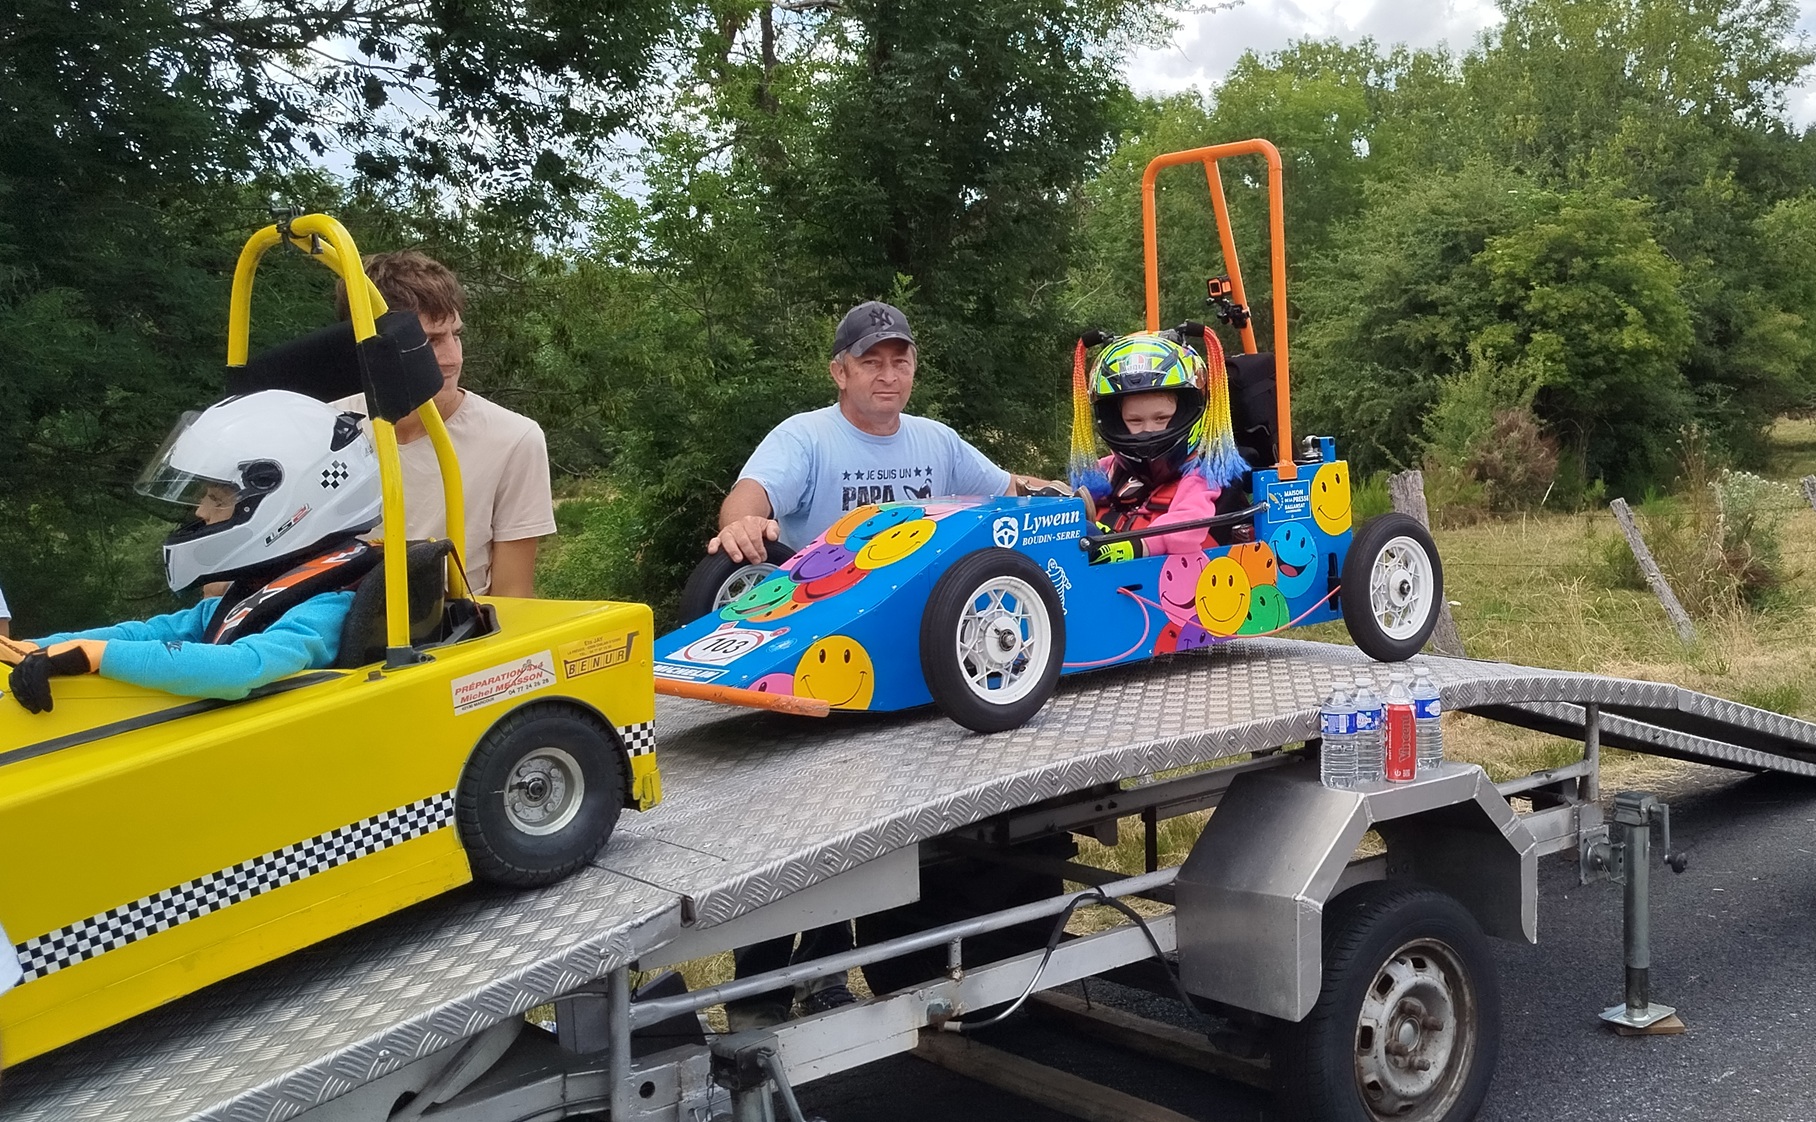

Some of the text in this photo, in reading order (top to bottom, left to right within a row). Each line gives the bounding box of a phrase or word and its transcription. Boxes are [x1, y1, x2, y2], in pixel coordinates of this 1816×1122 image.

[866, 468, 911, 480] JE SUIS UN
[842, 485, 895, 511] PAPA
[1284, 489, 1304, 497] MAISON
[265, 503, 311, 547] LS2
[1022, 510, 1080, 534] Lywenn
[1022, 530, 1081, 546] BOUDIN-SERRE
[702, 638, 749, 654] 103
[569, 650, 624, 675] BENUR
[653, 664, 720, 679] MICHELIN
[454, 661, 544, 696] PRÉPARATION 4x4
[460, 671, 544, 704] Michel MÉASSON
[1399, 715, 1411, 763] Vincent
